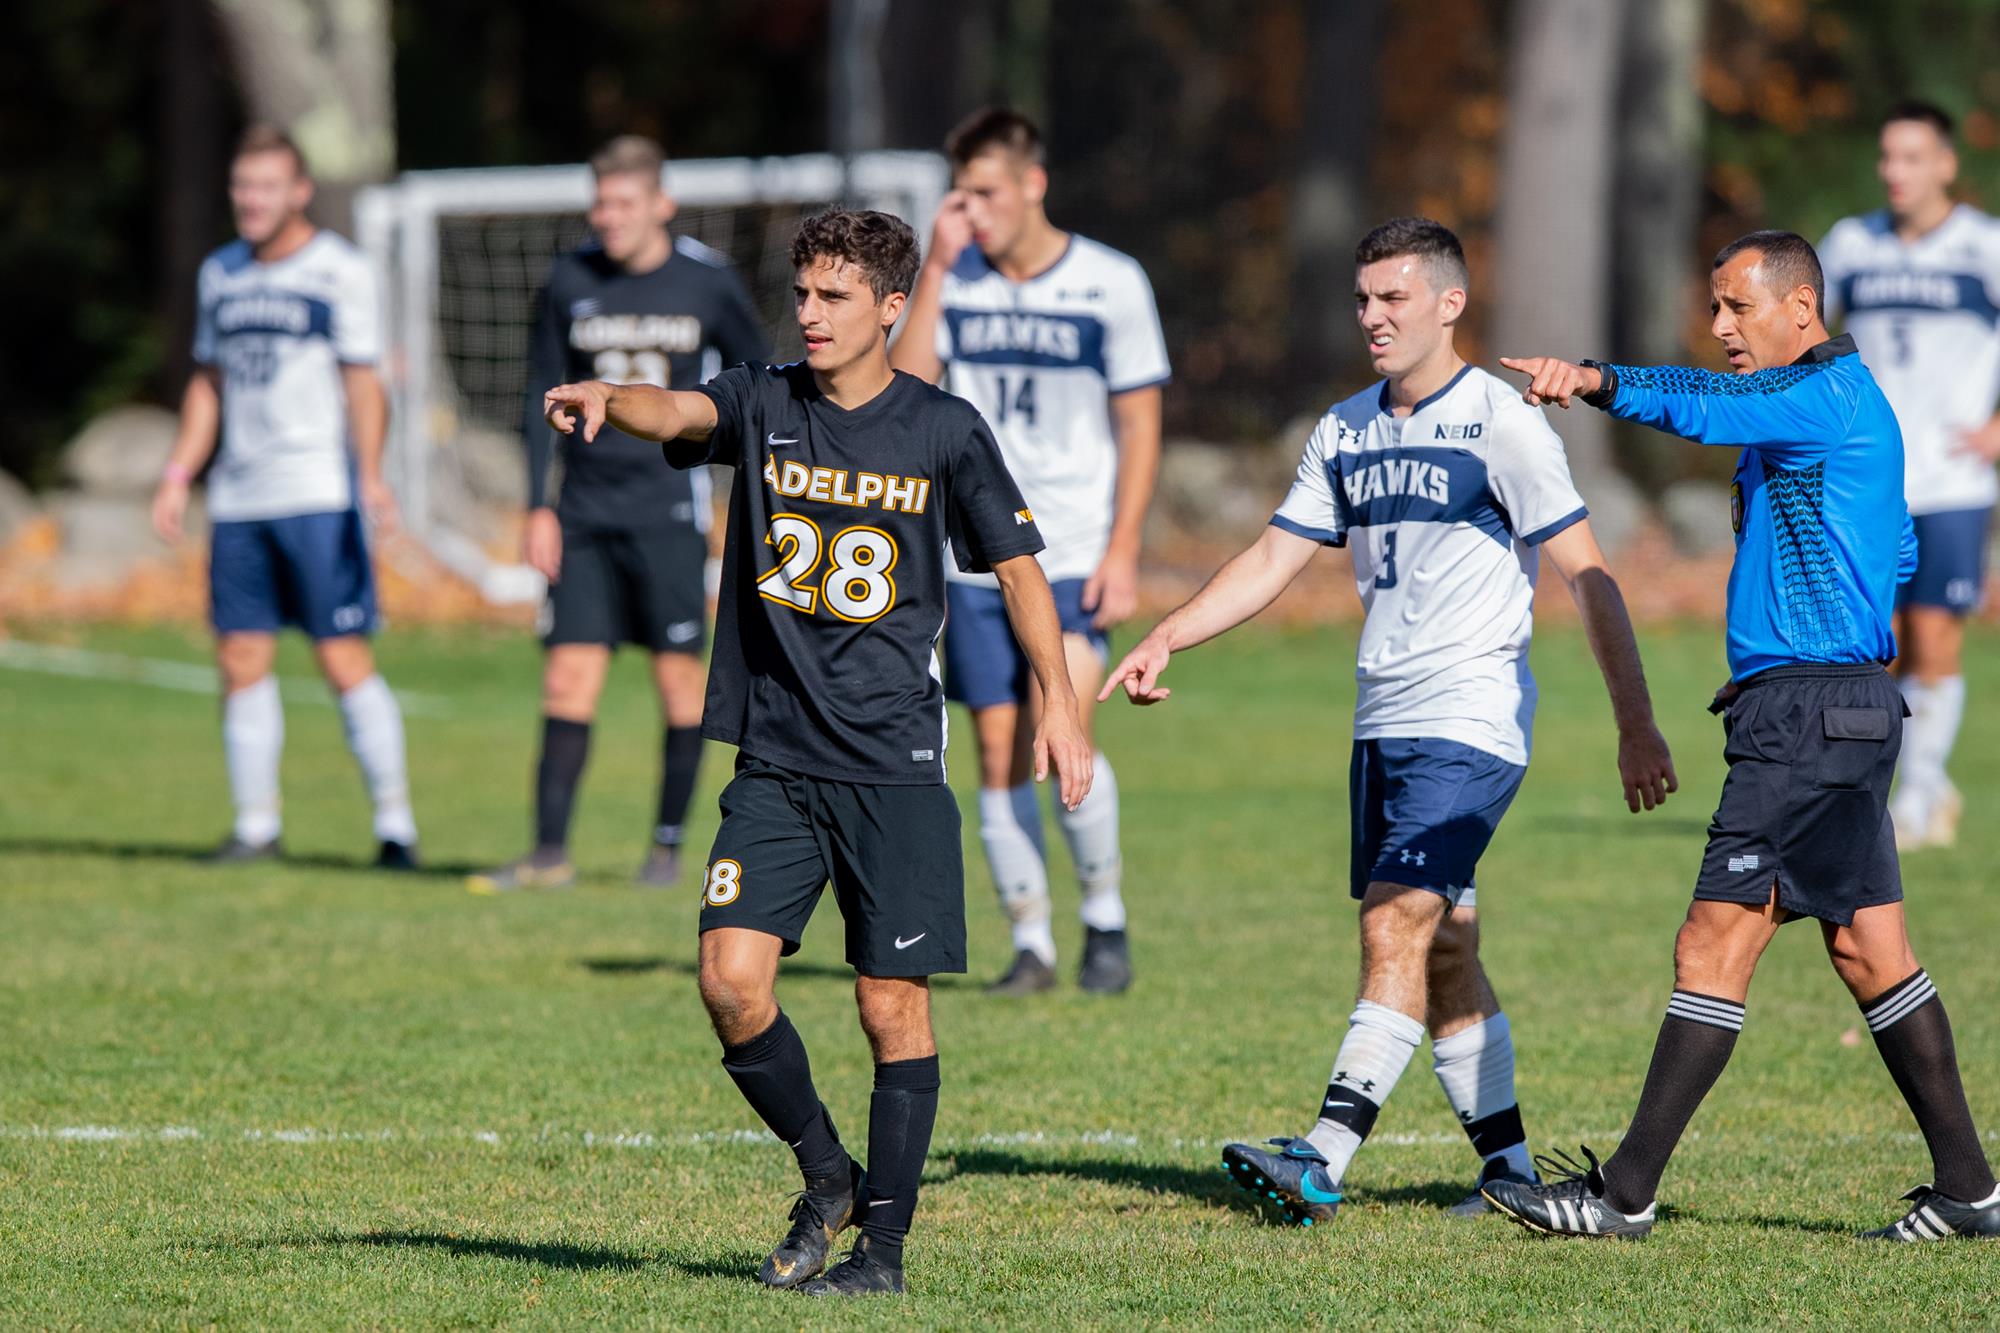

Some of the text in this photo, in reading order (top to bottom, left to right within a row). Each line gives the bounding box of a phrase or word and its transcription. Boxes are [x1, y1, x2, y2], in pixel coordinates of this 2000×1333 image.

[959, 314, 1081, 361] HAWKS
[996, 375, 1036, 425] 14
[1434, 423, 1483, 440] NE10
[763, 453, 931, 515] ADELPHI
[1344, 458, 1450, 507] HAWKS
[756, 512, 899, 624] 28
[1374, 529, 1398, 589] 3
[701, 858, 742, 910] 8
